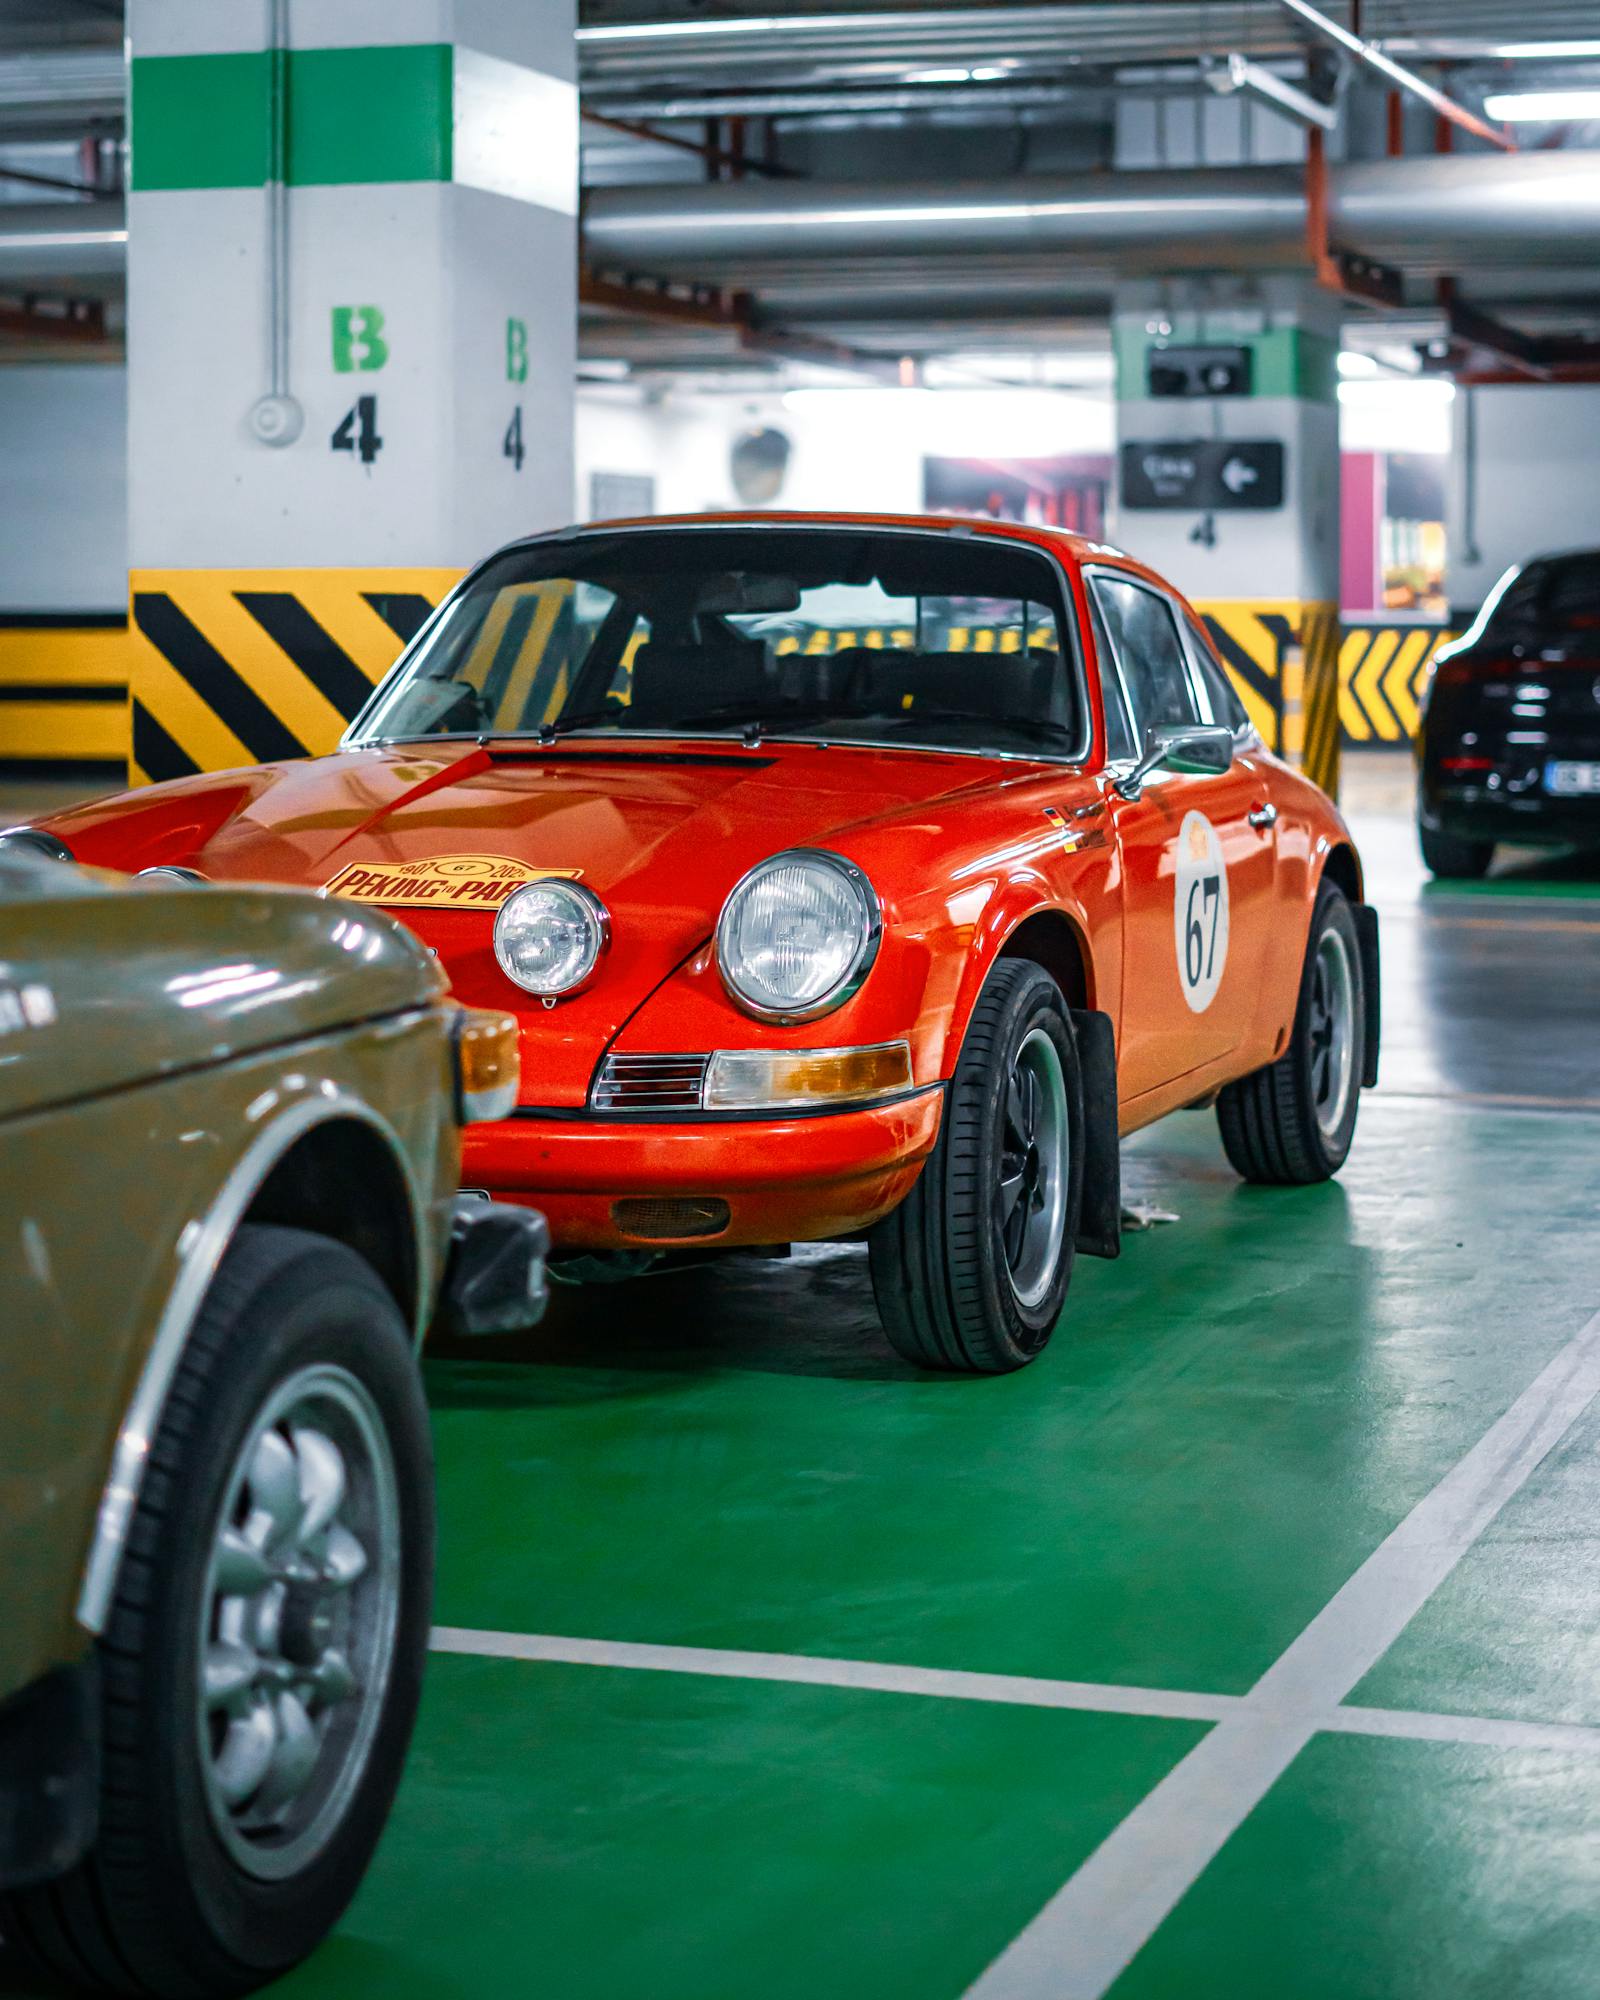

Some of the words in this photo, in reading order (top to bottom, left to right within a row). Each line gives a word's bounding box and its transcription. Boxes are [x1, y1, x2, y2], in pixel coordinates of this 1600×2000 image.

[332, 306, 389, 373] B
[506, 316, 529, 384] B
[331, 395, 383, 464] 4
[504, 404, 526, 471] 4
[329, 869, 449, 898] PEKING
[451, 881, 526, 901] PAR
[398, 862, 437, 876] 1907
[1186, 875, 1220, 988] 67
